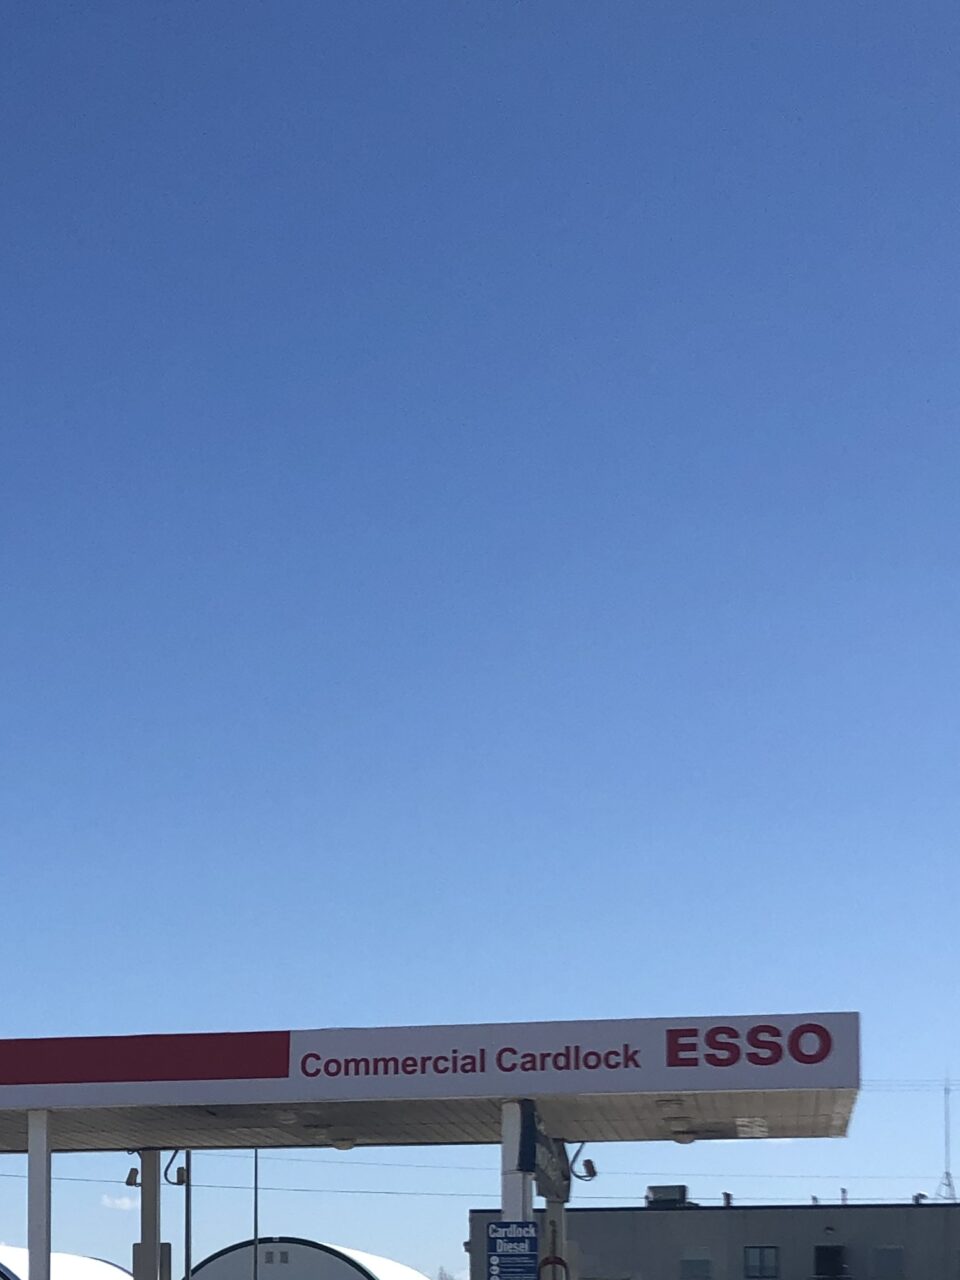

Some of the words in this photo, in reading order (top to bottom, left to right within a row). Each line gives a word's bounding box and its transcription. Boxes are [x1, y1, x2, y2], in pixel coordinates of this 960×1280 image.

[665, 1023, 833, 1068] ESSO
[300, 1048, 486, 1078] Commercial
[496, 1044, 642, 1073] Cardlock
[488, 1224, 536, 1238] Cardlock
[496, 1239, 529, 1252] Diesel
